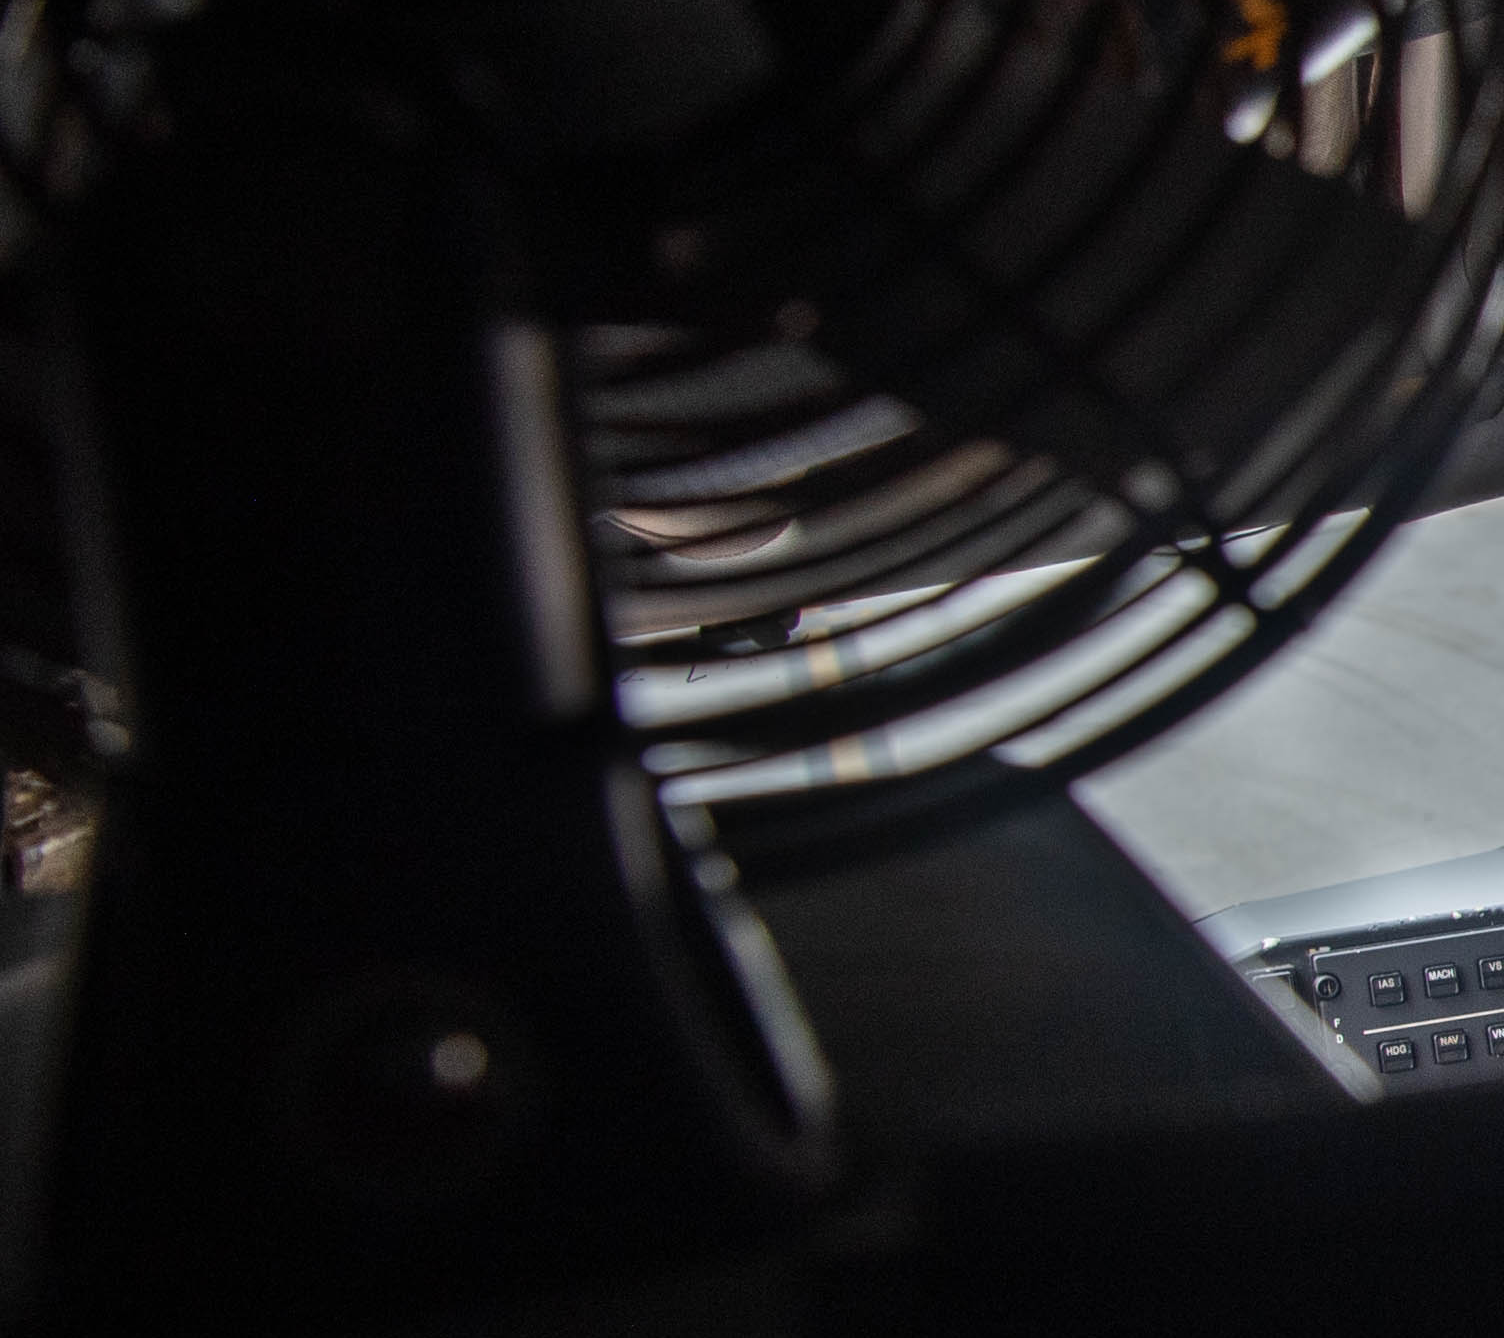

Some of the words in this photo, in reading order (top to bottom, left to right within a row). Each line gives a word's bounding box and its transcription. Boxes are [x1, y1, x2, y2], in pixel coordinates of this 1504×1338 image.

[1378, 978, 1395, 990] IAS
[1428, 969, 1454, 982] MACH
[1488, 961, 1502, 972] VS
[1386, 1045, 1407, 1057] HDG
[1440, 1035, 1459, 1046] NAV
